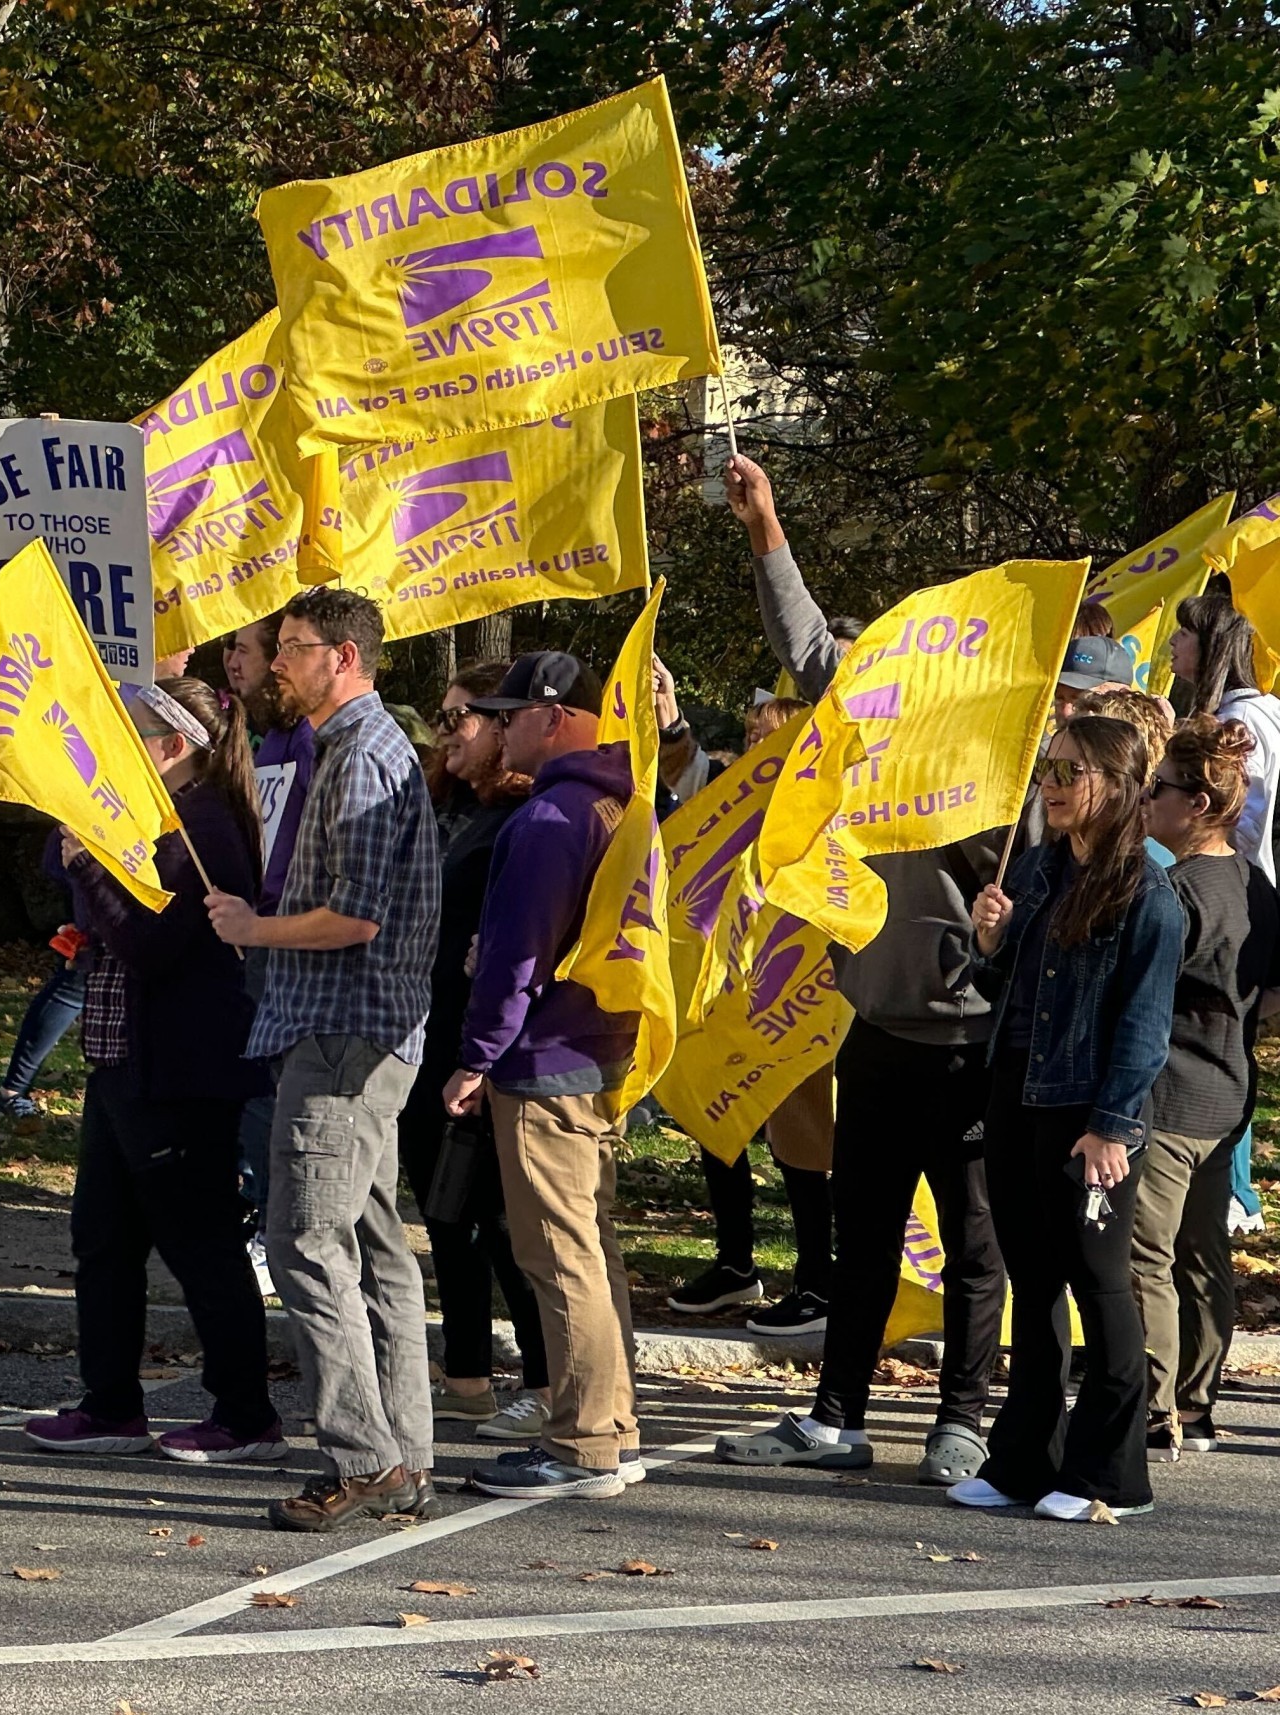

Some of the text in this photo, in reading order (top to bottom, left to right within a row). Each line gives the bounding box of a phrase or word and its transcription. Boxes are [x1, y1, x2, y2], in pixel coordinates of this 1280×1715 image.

[42, 436, 126, 492] FAIR
[3, 513, 111, 535] TO THOSE
